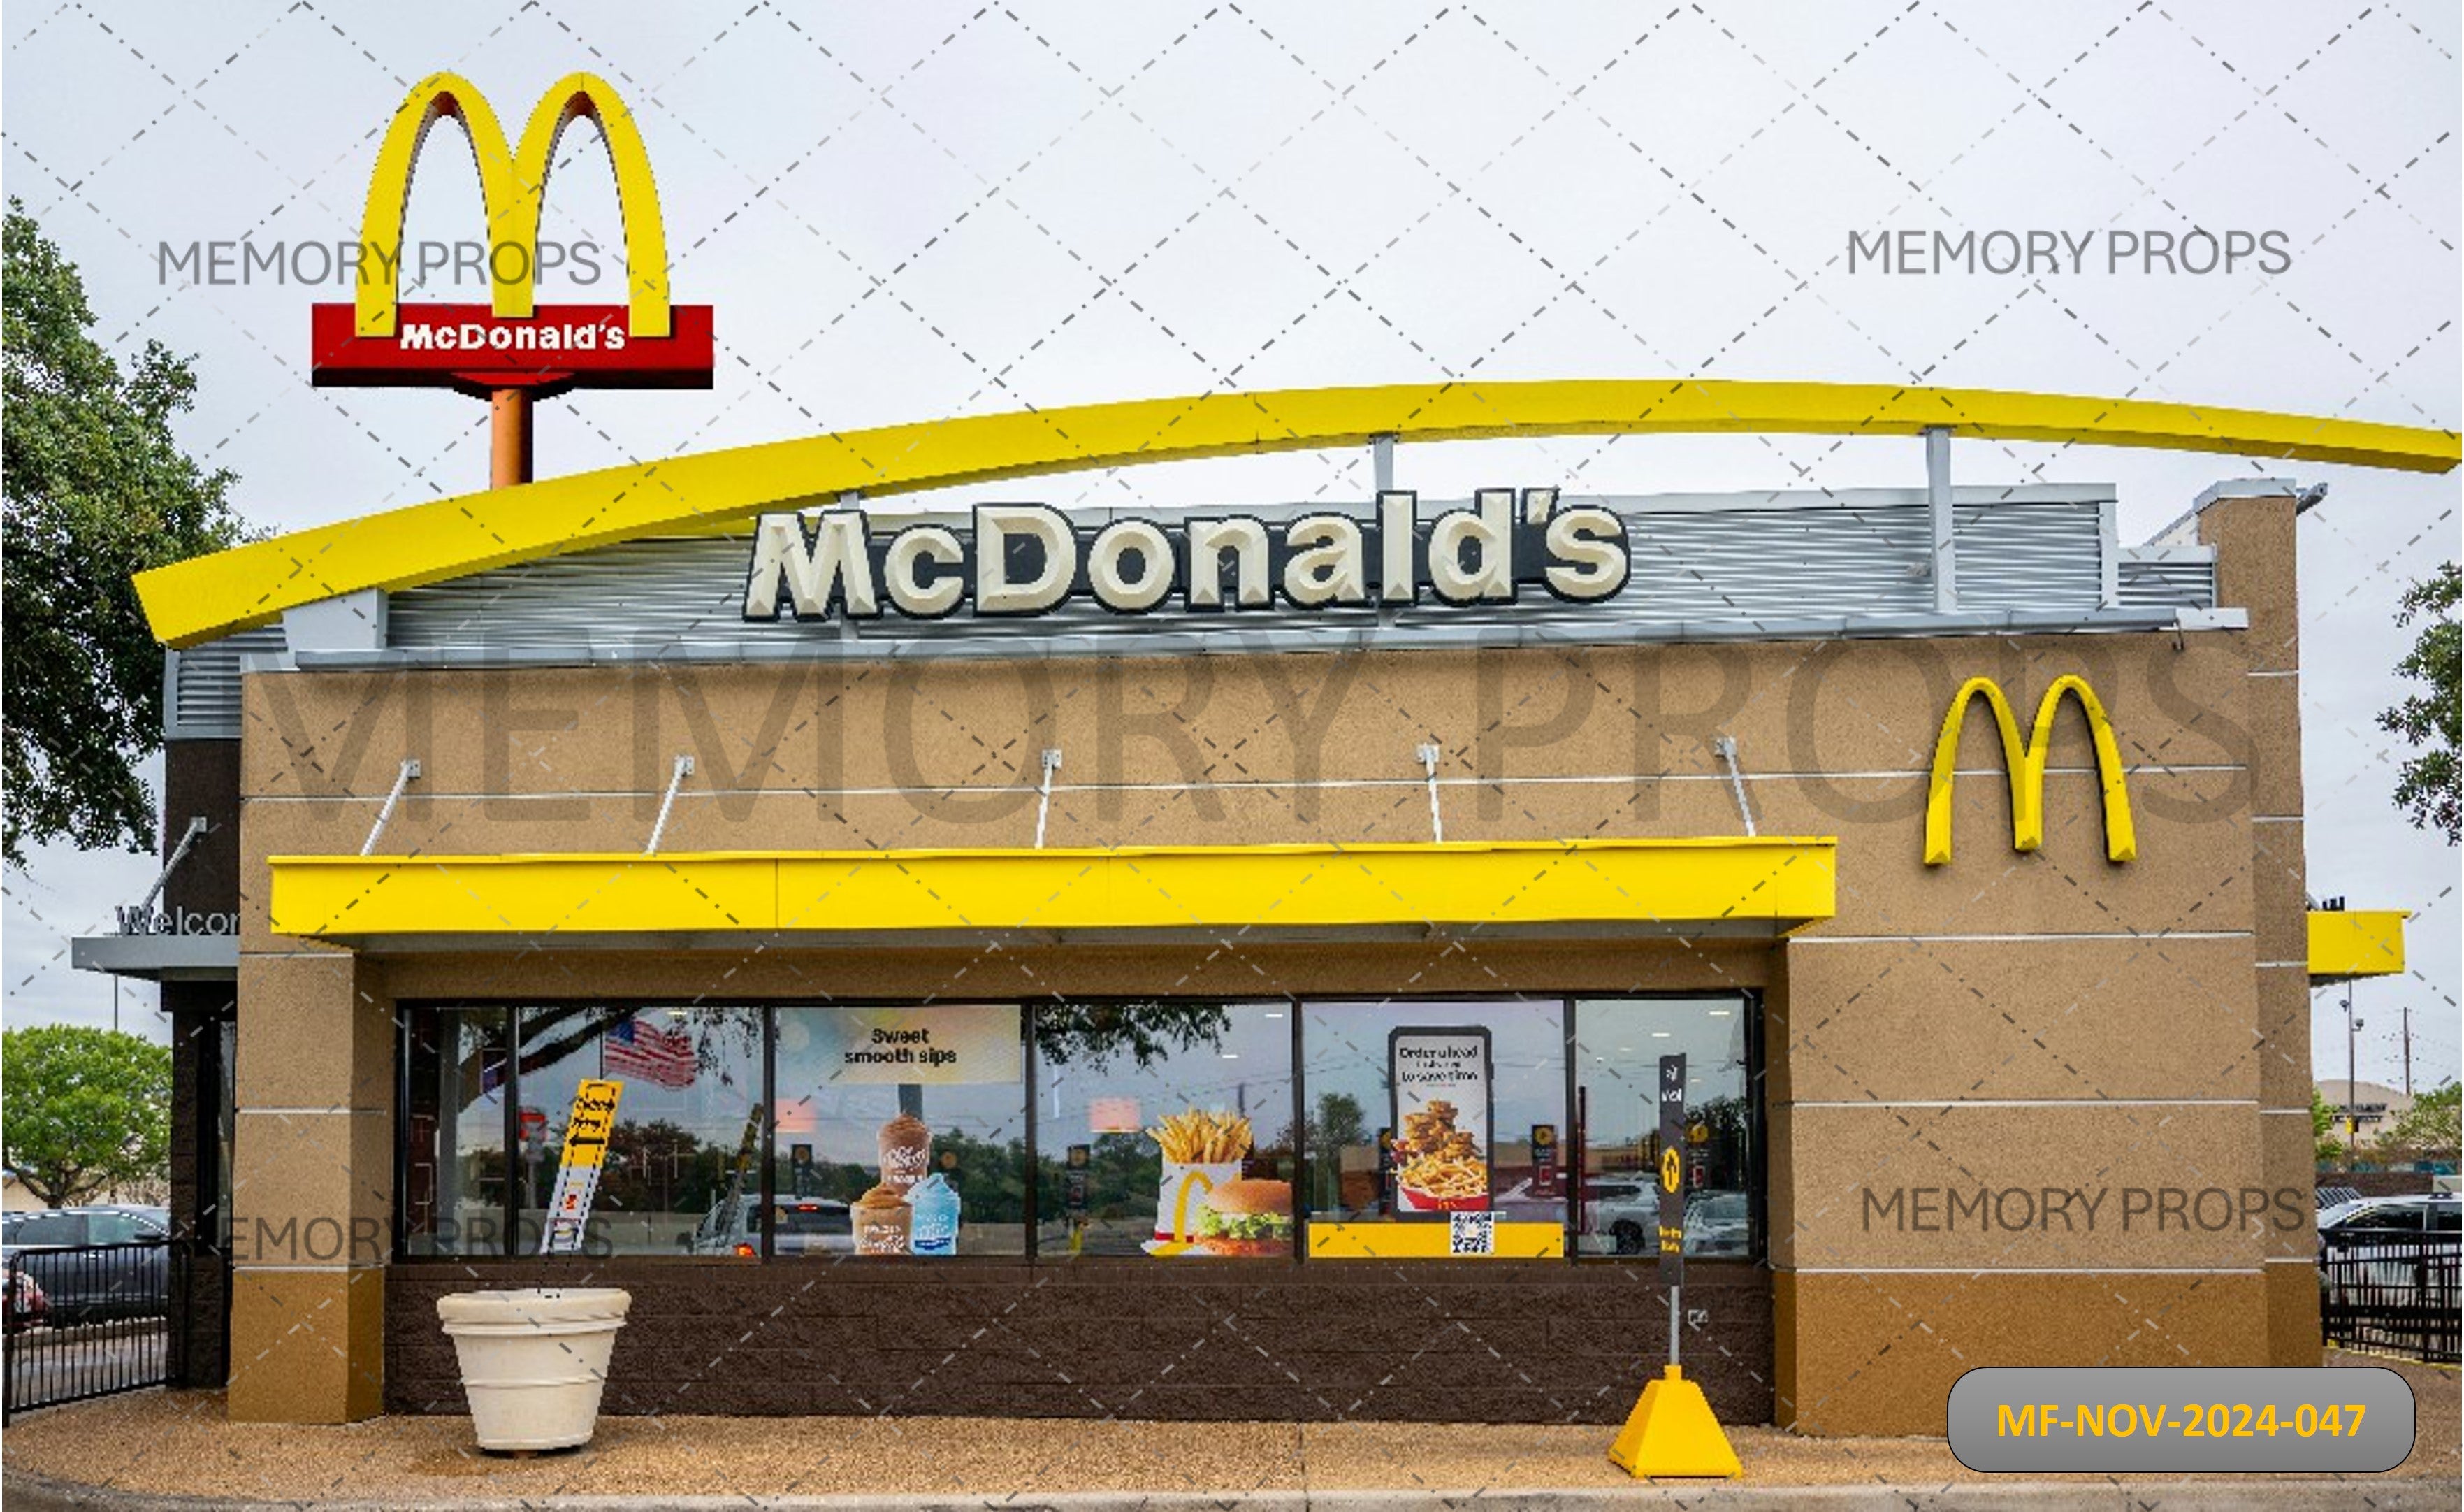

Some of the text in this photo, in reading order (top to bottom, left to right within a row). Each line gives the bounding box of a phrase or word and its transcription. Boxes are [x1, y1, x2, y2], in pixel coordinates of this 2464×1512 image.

[400, 322, 625, 351] McDonald's
[742, 487, 1632, 621] McDonald's
[871, 1028, 930, 1044] Sweet
[844, 1048, 957, 1067] smooth sips
